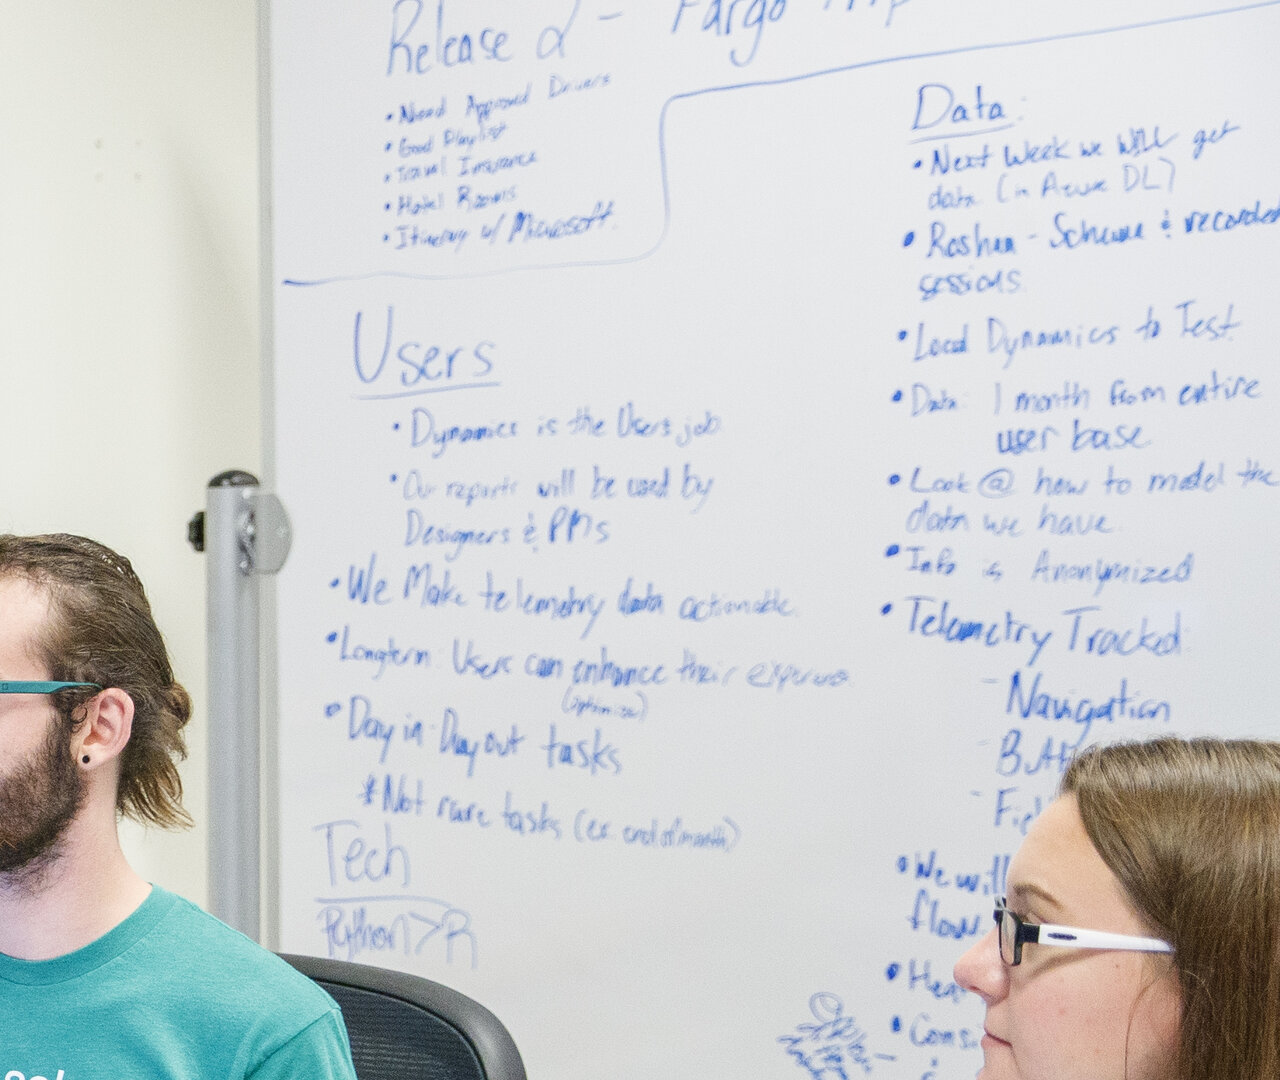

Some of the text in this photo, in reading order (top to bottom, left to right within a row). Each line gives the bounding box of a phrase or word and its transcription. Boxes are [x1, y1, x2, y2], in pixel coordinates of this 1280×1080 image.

[386, 0, 513, 77] Release
[458, 150, 538, 177] Insurance
[1192, 119, 1241, 160] get
[353, 304, 498, 387] Users
[986, 316, 1120, 370] Dynamics
[1134, 305, 1162, 341] to
[1014, 380, 1091, 412] month
[1109, 378, 1166, 408] from
[410, 406, 519, 460] Dynamics
[567, 404, 606, 439] the
[675, 408, 722, 449] job
[1070, 417, 1153, 453] base
[591, 463, 618, 501] be
[679, 461, 716, 515] by
[1104, 463, 1133, 495] to
[1036, 502, 1114, 537] have
[347, 552, 393, 604] We
[1060, 604, 1184, 658] Tracked
[347, 694, 394, 764] Day
[541, 722, 623, 777] tasks
[313, 819, 412, 889] Tech
[914, 850, 950, 887] We
